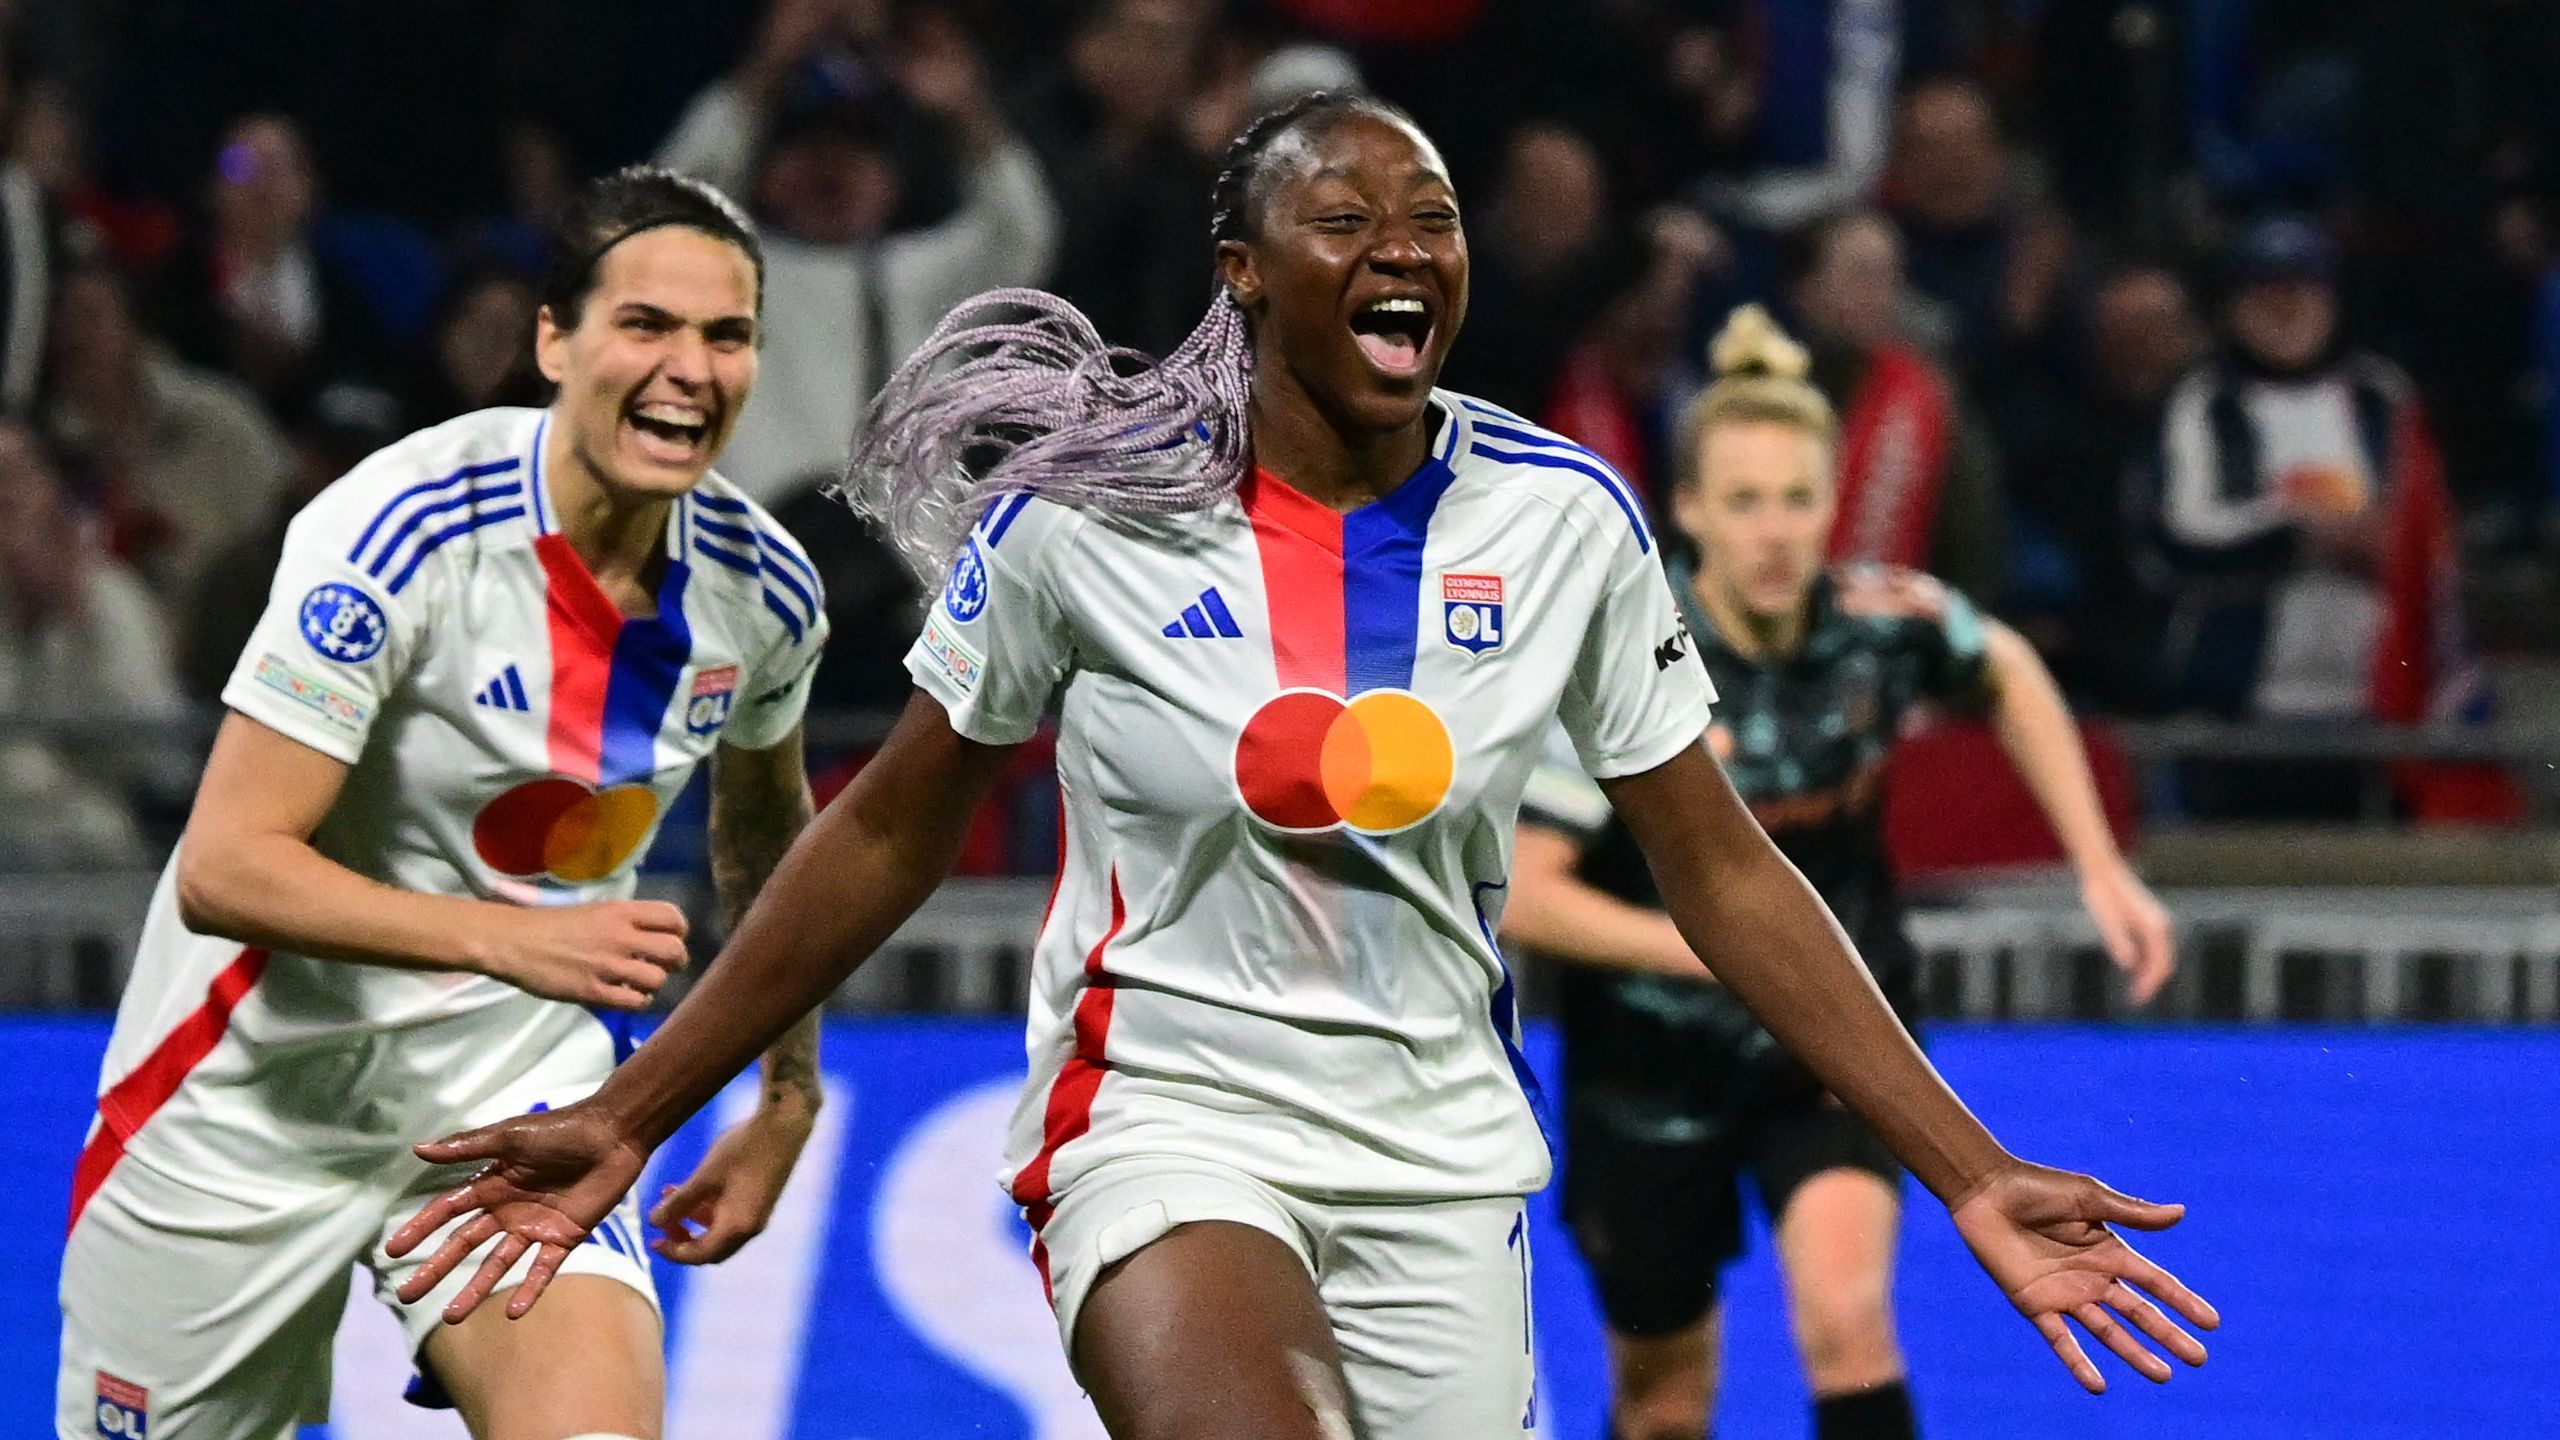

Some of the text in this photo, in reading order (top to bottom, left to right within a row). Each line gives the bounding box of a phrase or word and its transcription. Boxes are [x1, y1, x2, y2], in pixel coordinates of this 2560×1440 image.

[1446, 588, 1500, 600] LYONNAIS
[330, 604, 356, 637] 8
[1448, 604, 1500, 643] OL
[99, 1403, 143, 1440] OL
